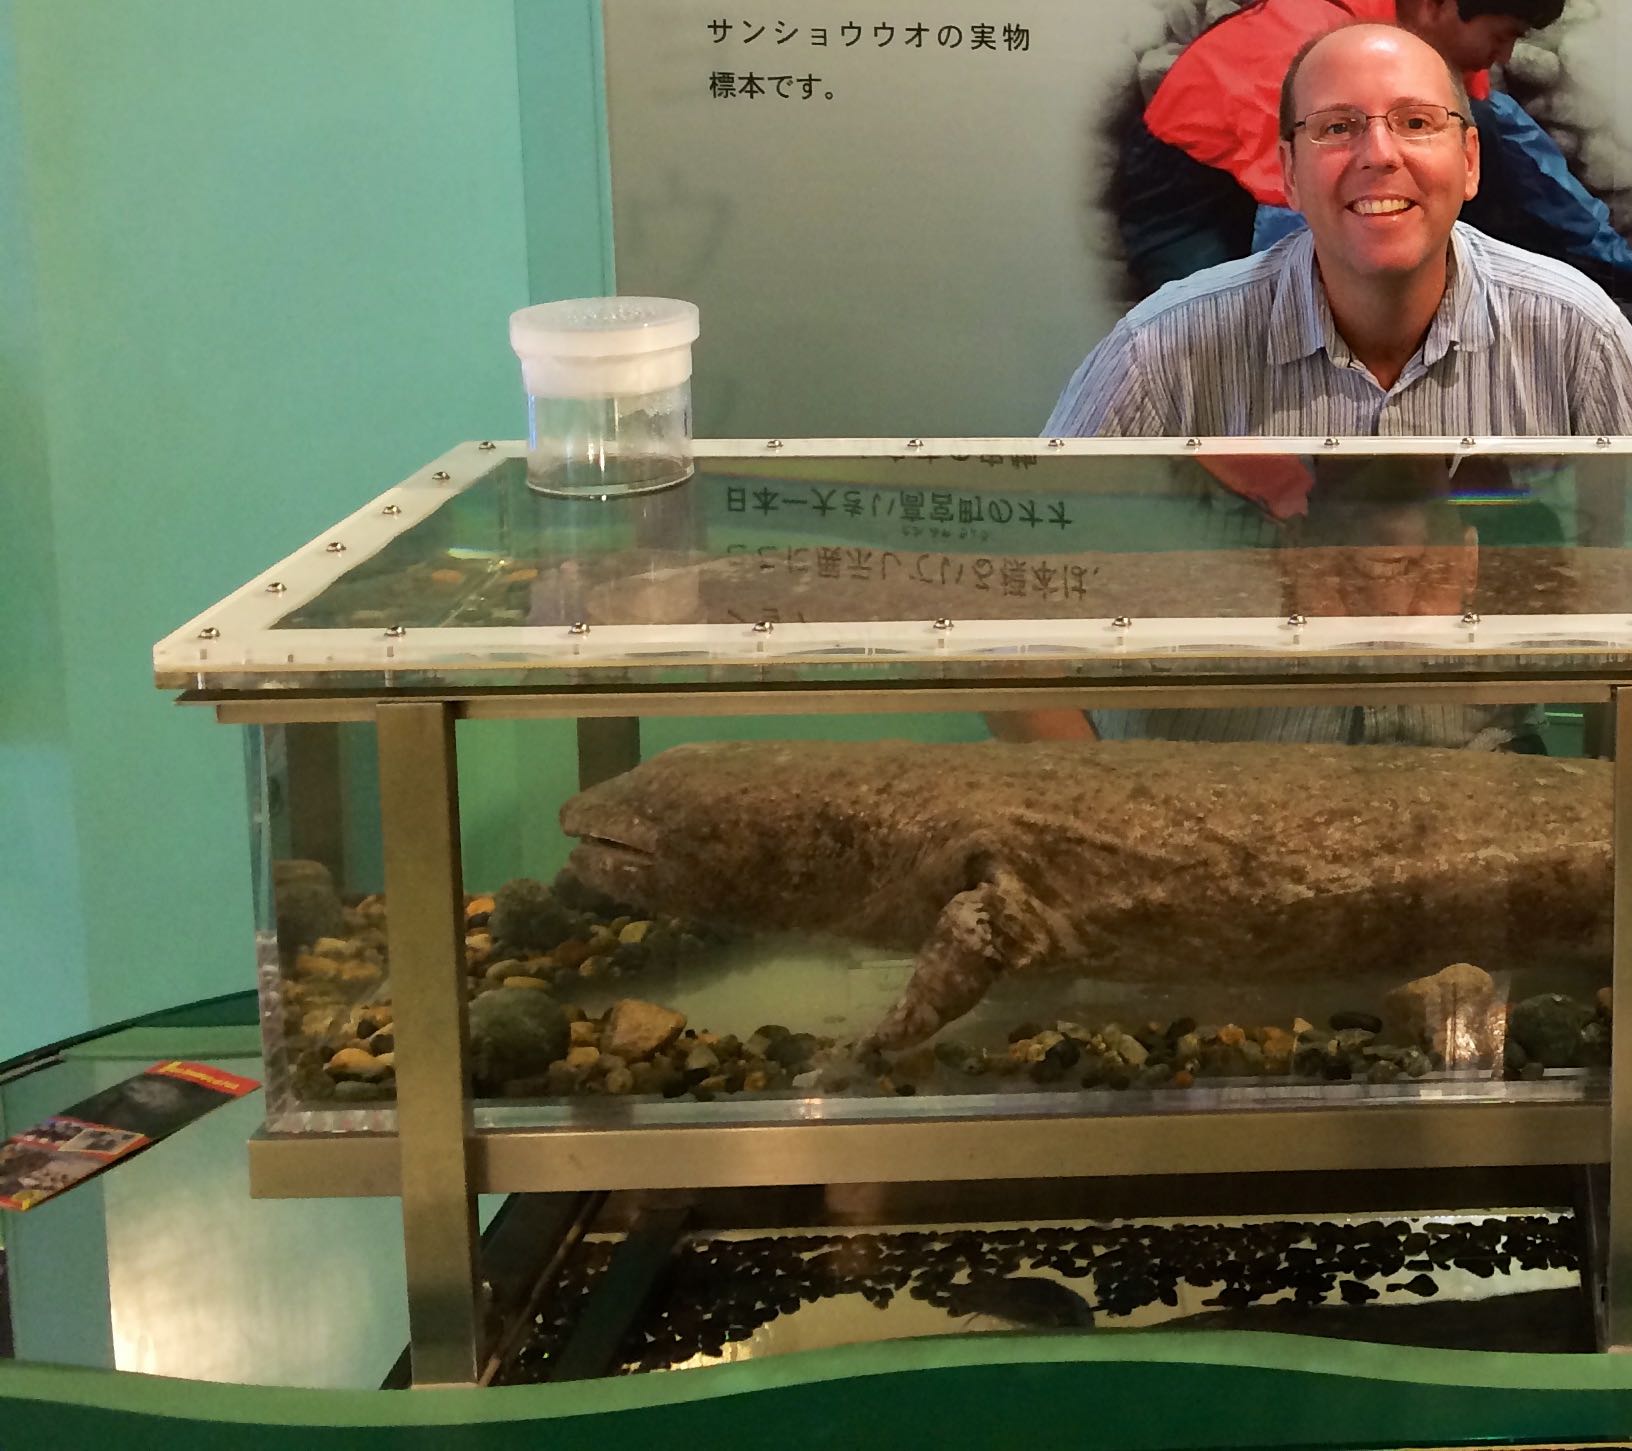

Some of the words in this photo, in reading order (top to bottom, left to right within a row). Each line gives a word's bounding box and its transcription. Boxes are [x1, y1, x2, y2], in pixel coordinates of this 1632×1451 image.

[707, 19, 1031, 52] サンショウウオの実物
[708, 71, 835, 101] 標本です。
